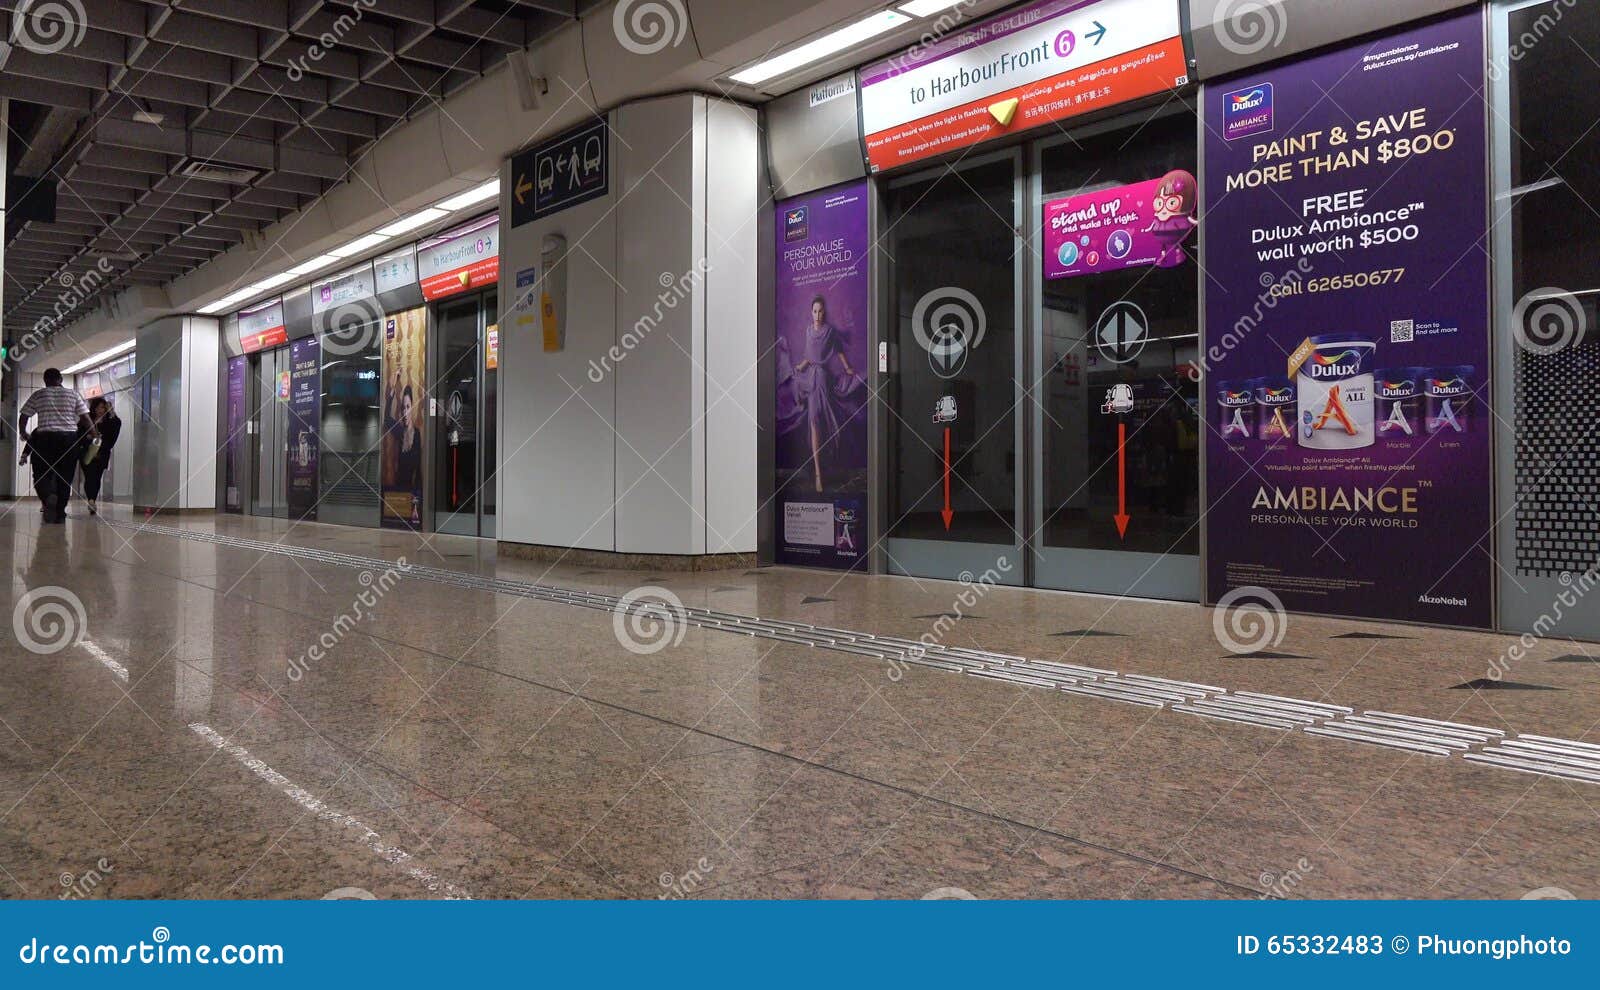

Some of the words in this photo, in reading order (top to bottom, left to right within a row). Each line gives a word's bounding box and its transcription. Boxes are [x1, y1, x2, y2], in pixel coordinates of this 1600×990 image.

[910, 87, 925, 104] to
[931, 41, 1049, 98] HarbourFront
[1177, 77, 1187, 86] 20
[811, 80, 844, 103] Platform
[846, 78, 854, 89] A
[1232, 99, 1260, 112] Dulux
[1229, 114, 1268, 130] AMBIANCE
[1253, 131, 1323, 163] PAINT
[1329, 126, 1348, 146] &
[1356, 108, 1426, 140] SAVE
[1225, 162, 1293, 192] MORE
[1298, 146, 1369, 177] THAN
[1051, 203, 1098, 229] stand
[1101, 198, 1121, 218] up
[1080, 220, 1102, 230] make
[1103, 217, 1111, 226] it
[1252, 224, 1303, 244] Dulux
[784, 238, 844, 261] PERSONALISE
[1257, 243, 1295, 262] wall
[1300, 234, 1354, 256] worth
[1360, 224, 1419, 249] $500
[790, 258, 815, 272] YOUR
[817, 250, 852, 267] WORLD
[1269, 280, 1303, 298] Call
[1308, 267, 1405, 294] 62650677
[1311, 363, 1355, 377] Dulux
[1265, 394, 1289, 402] Dulux
[1346, 393, 1366, 402] ALL
[1383, 388, 1411, 396] Dulux
[1432, 386, 1460, 394] Dulux
[1251, 514, 1329, 526] PERSONALISE
[1332, 516, 1366, 527] YOUR
[1370, 517, 1418, 529] WORLD
[1418, 594, 1467, 607] AkzoNobel
